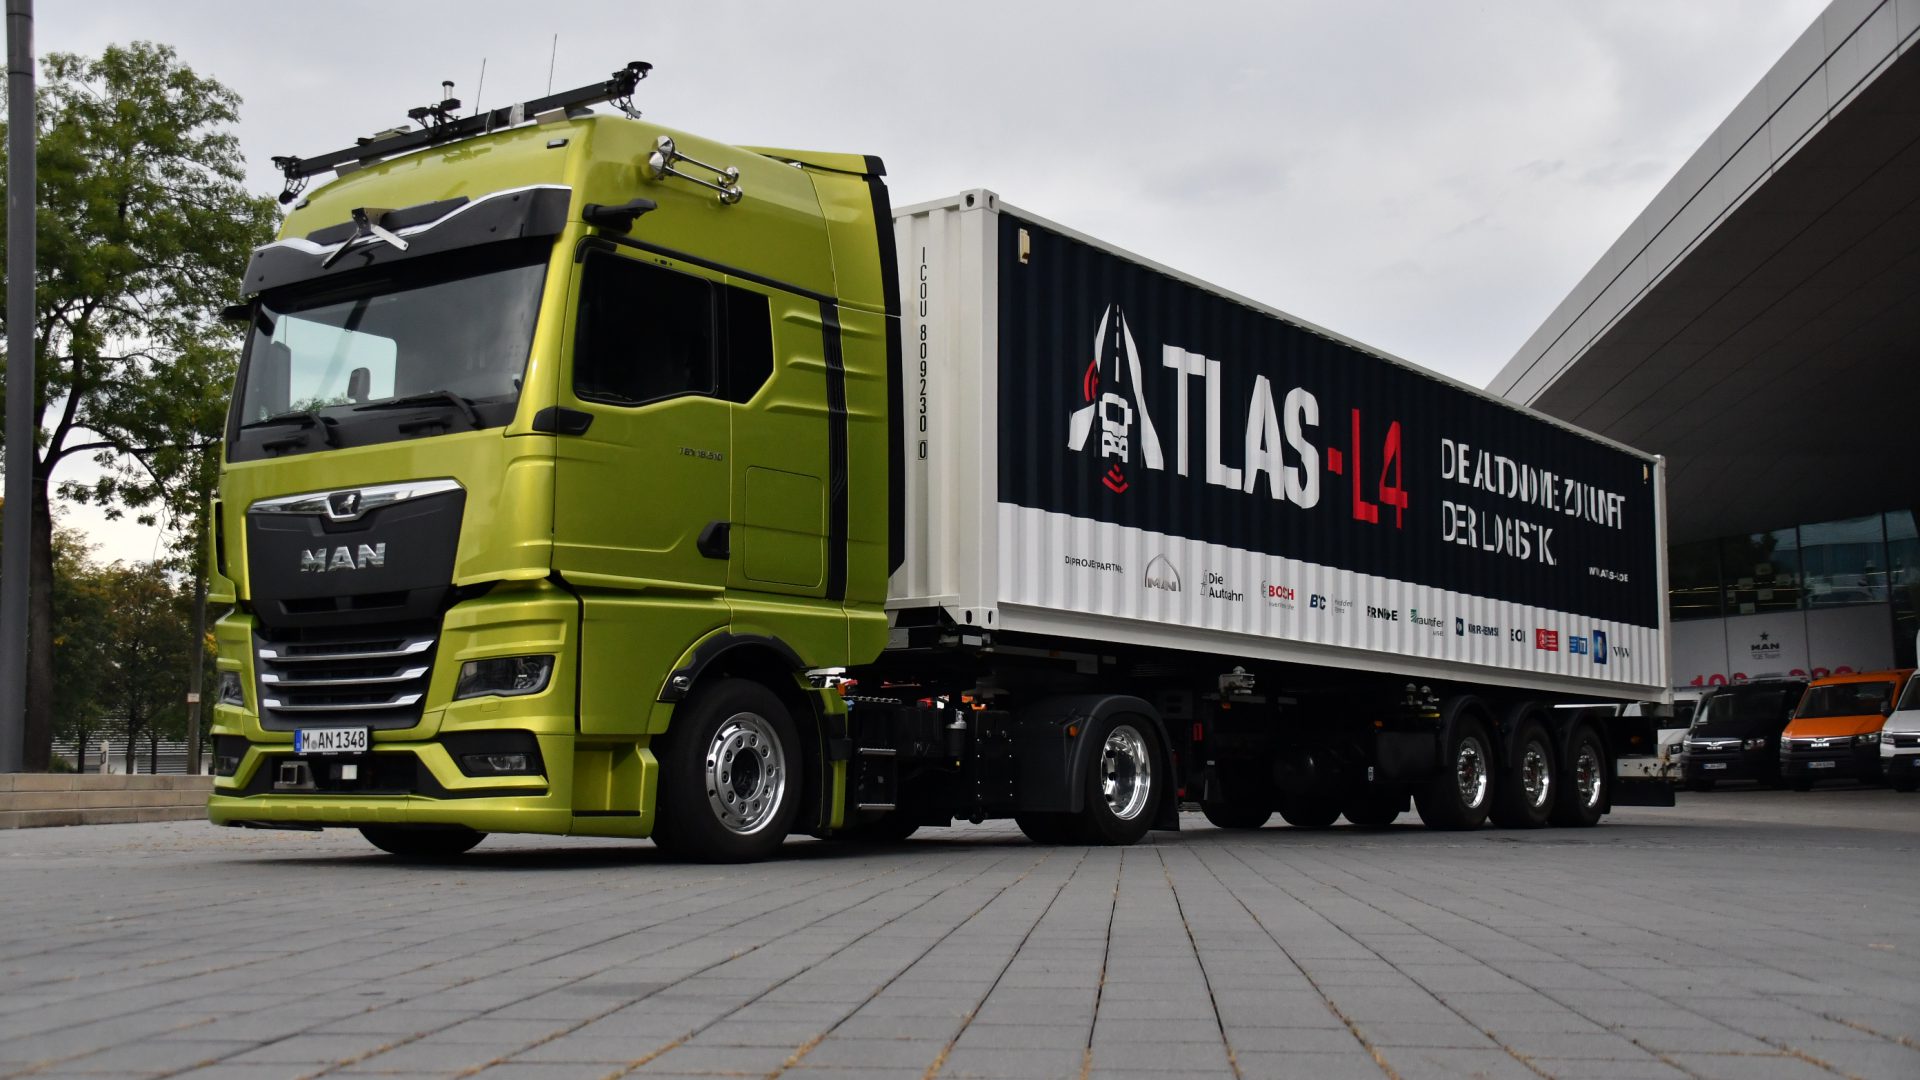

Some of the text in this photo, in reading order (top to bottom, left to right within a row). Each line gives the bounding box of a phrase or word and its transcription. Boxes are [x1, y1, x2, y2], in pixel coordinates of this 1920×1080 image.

[919, 247, 927, 317] ICOU
[919, 325, 927, 432] 809230
[1441, 438, 1470, 484] DE
[1442, 500, 1478, 548] DER
[300, 543, 386, 573] MAN
[1209, 572, 1223, 584] Die
[1751, 642, 1780, 651] MAN
[302, 731, 365, 749] M AN 1348
